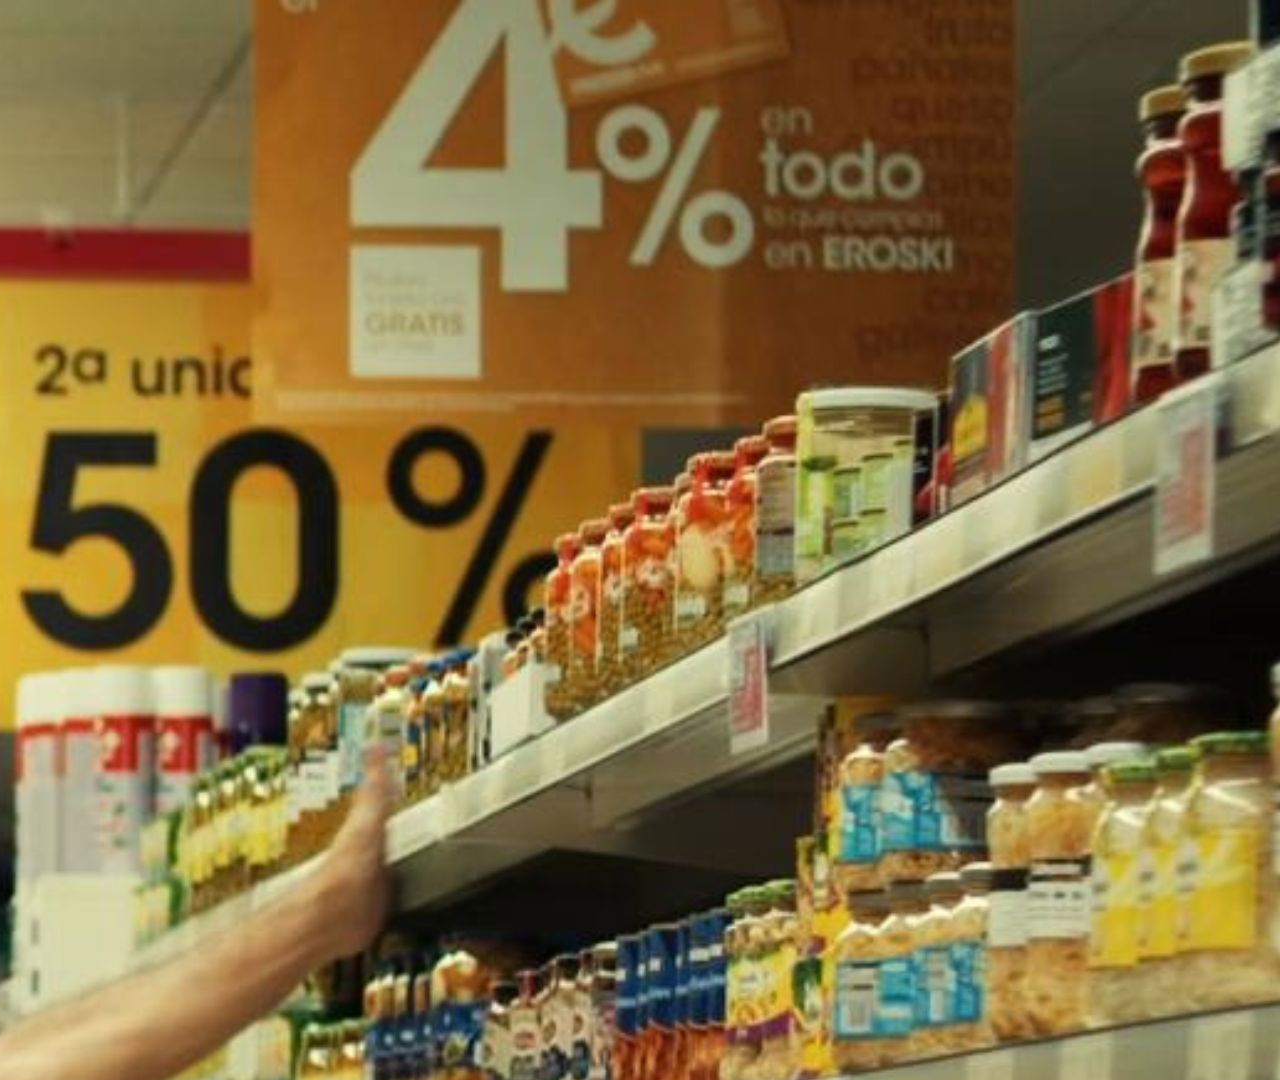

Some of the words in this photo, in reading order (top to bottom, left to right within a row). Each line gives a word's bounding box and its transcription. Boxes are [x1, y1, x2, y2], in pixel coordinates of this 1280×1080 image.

[761, 106, 813, 135] en
[760, 138, 924, 200] todo
[764, 241, 814, 270] en
[822, 235, 954, 272] EROSKI
[363, 310, 465, 337] GRATIS
[18, 428, 340, 654] 50
